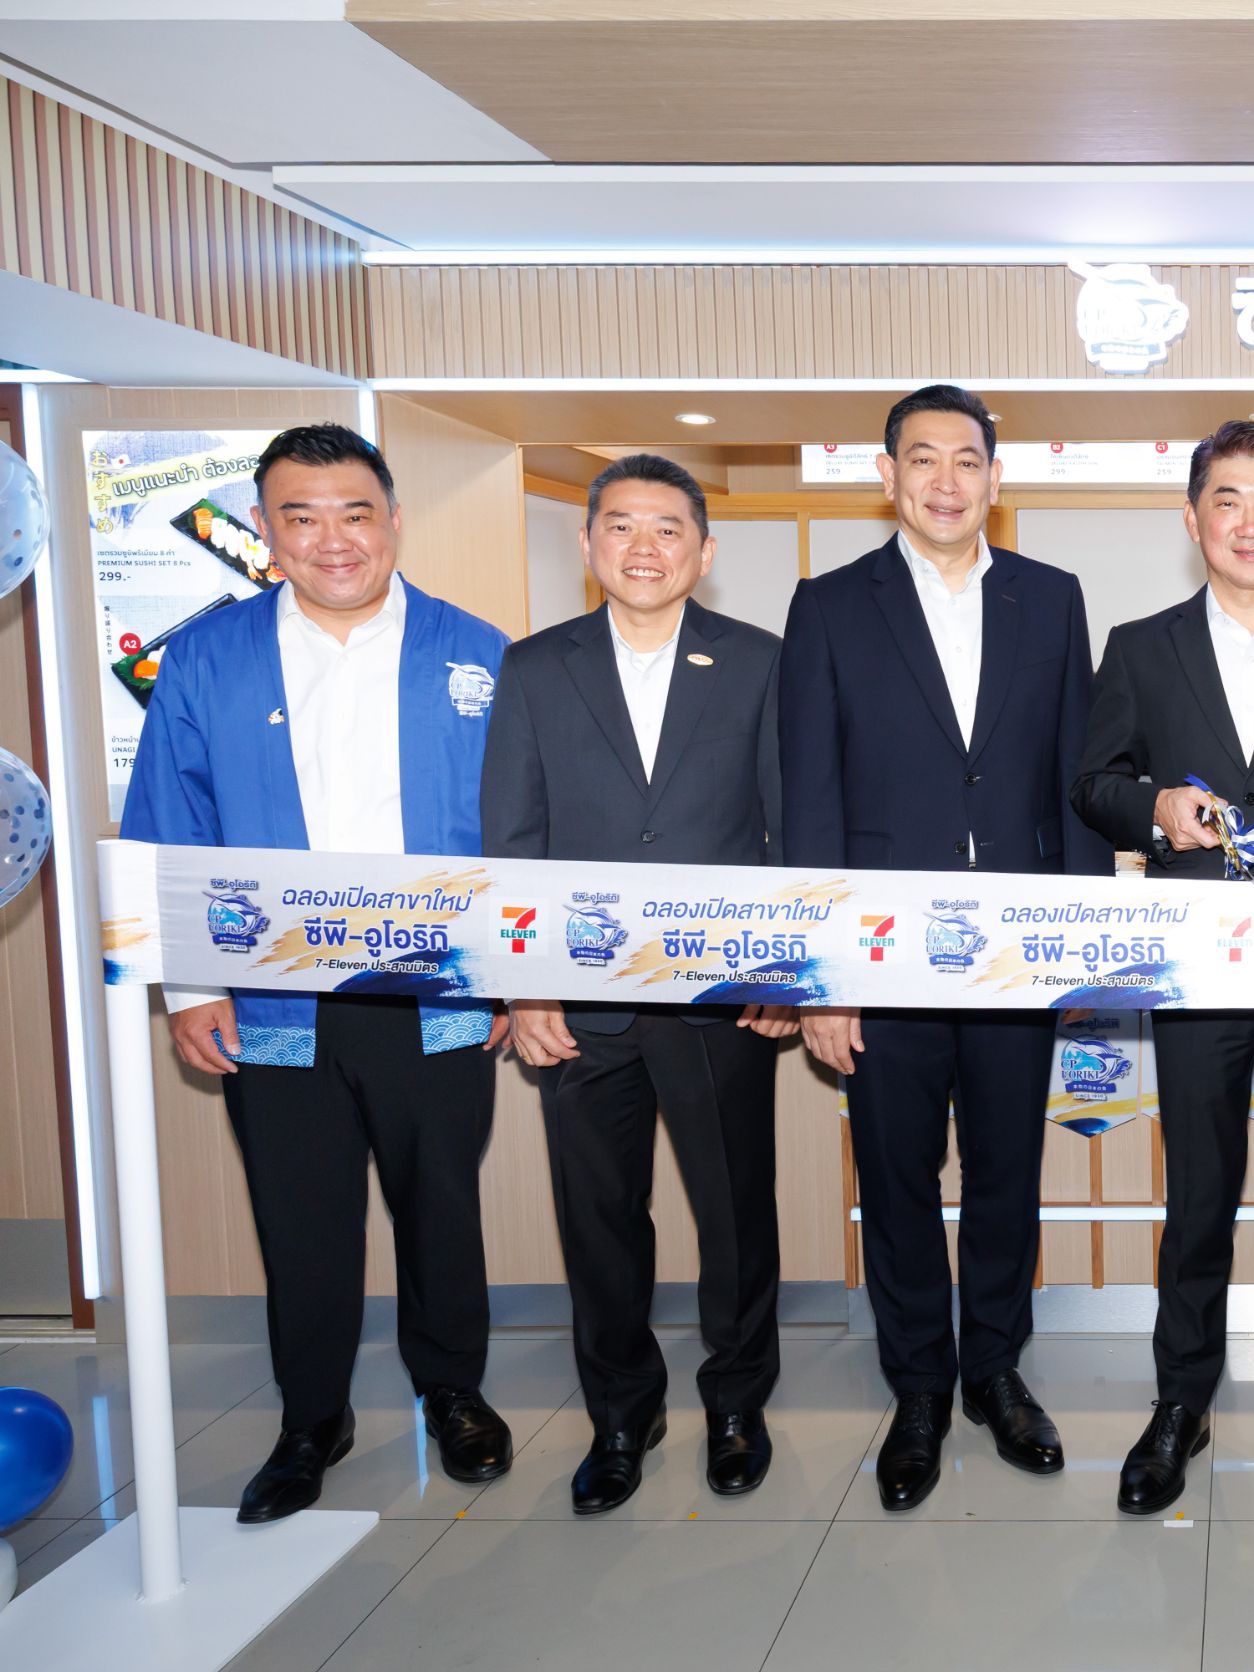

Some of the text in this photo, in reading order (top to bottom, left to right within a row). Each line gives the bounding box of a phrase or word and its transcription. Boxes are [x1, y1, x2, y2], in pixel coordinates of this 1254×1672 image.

[112, 463, 199, 497] เมนูแนะนำ
[92, 450, 113, 534] おすすめ
[99, 572, 131, 581] 299.-
[123, 640, 137, 649] A2
[282, 886, 472, 912] ฉลองเปิดสาขาใหม่
[642, 897, 832, 922] ฉลองเปิดสาขาใหม่
[1001, 902, 1190, 924] ฉลองเปิดสาขาใหม่
[304, 916, 448, 957] ซีพี-อูโอริกิ
[662, 927, 807, 968] ซีพี-อูโอริกิ
[1022, 934, 1165, 972] ซีพี-อูโอริกิ
[315, 958, 438, 973] 7-Eleven ประสานมิตร
[673, 970, 797, 984] 7-Eleven ประสานมิตร
[1032, 974, 1154, 987] 7-Eleven ประสานมิตร
[1061, 1060, 1077, 1068] CP
[1061, 1070, 1099, 1079] UORIKI
